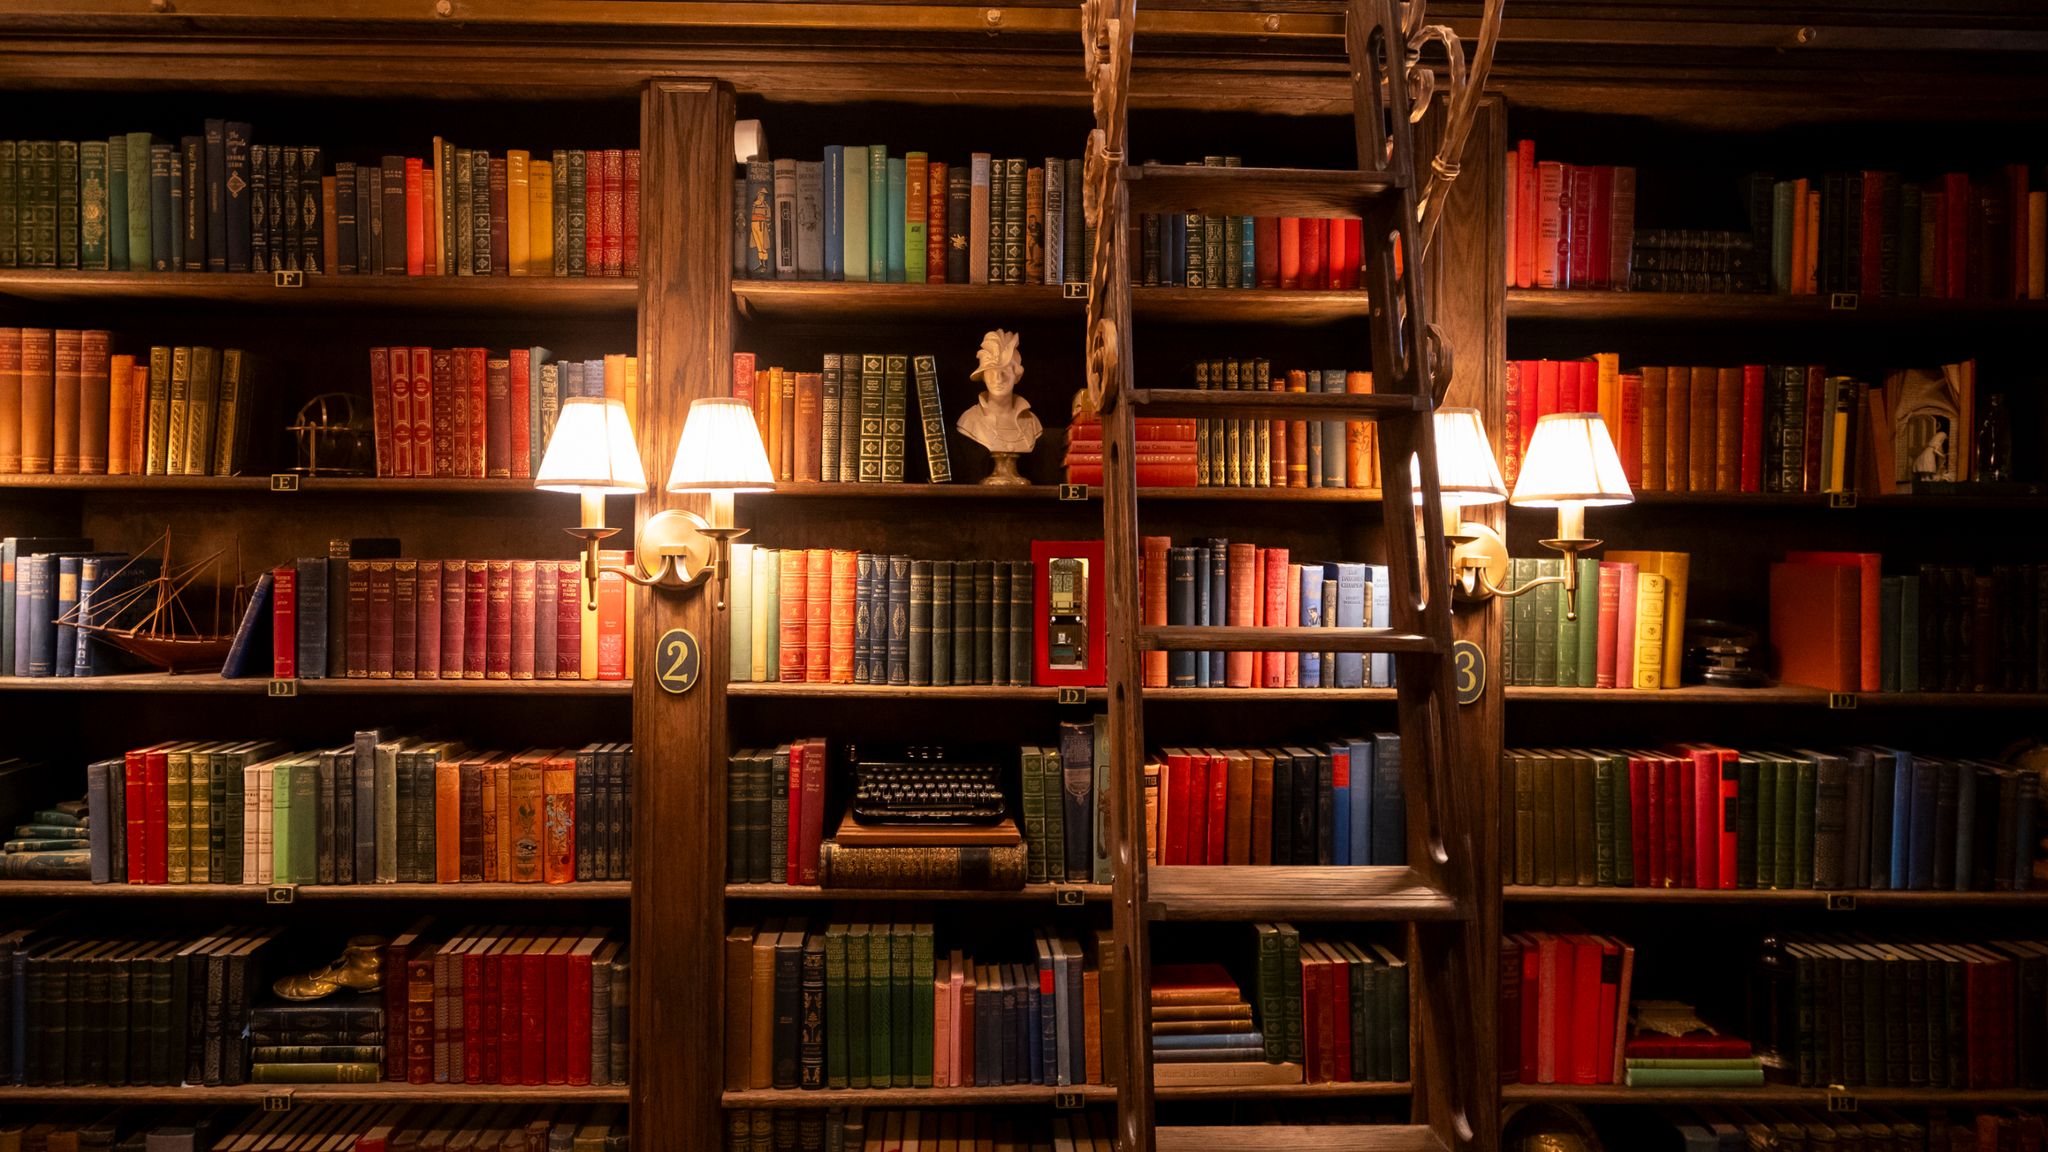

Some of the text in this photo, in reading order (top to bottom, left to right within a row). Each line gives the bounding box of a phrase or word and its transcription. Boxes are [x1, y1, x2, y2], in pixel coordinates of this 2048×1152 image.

[283, 272, 295, 286] F
[1071, 284, 1083, 297] F
[1840, 295, 1850, 307] F
[279, 476, 291, 489] E
[1067, 486, 1080, 499] E
[1839, 494, 1850, 506] E
[663, 640, 689, 684] 2
[1455, 650, 1477, 692] 3
[275, 682, 288, 695] D
[1066, 689, 1079, 702] D
[1837, 695, 1850, 707] D
[273, 889, 286, 902] C
[1064, 891, 1077, 903] C
[1837, 896, 1850, 908] C
[272, 1097, 283, 1110] B
[1064, 1094, 1076, 1107] B
